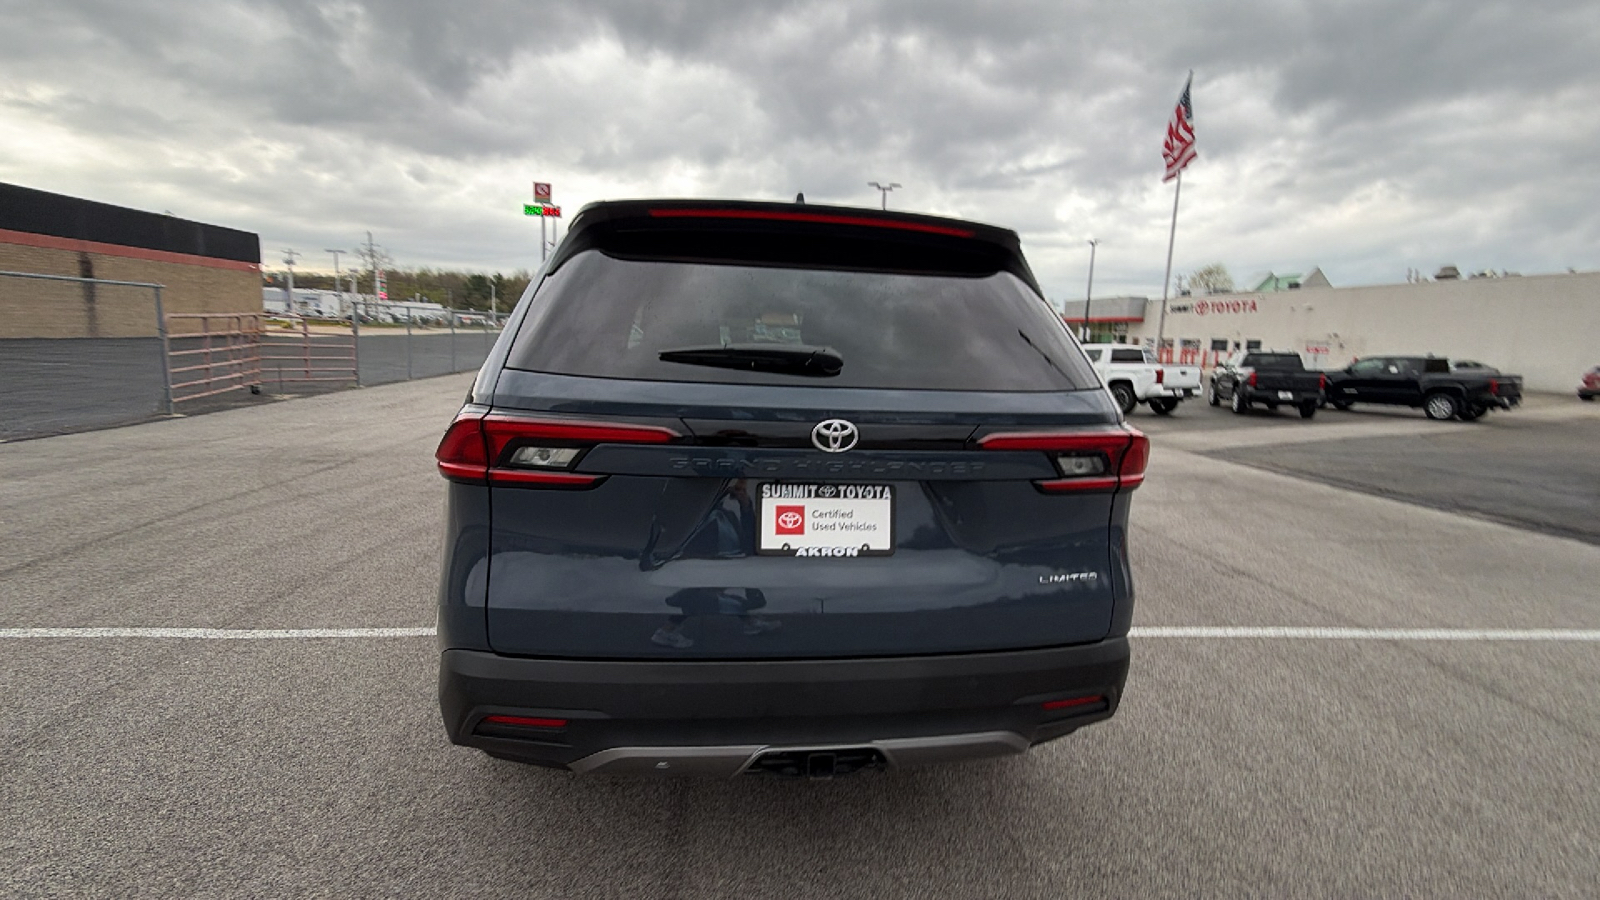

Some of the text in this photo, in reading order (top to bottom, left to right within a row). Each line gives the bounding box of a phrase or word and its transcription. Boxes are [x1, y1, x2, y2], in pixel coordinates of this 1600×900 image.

[1210, 300, 1257, 314] TOYOTA
[669, 457, 782, 471] GRAND
[762, 484, 892, 500] SUMMIT TOYOTA
[811, 509, 854, 520] Certified
[811, 521, 878, 532] Used Vehicles
[795, 546, 859, 558] AKRON
